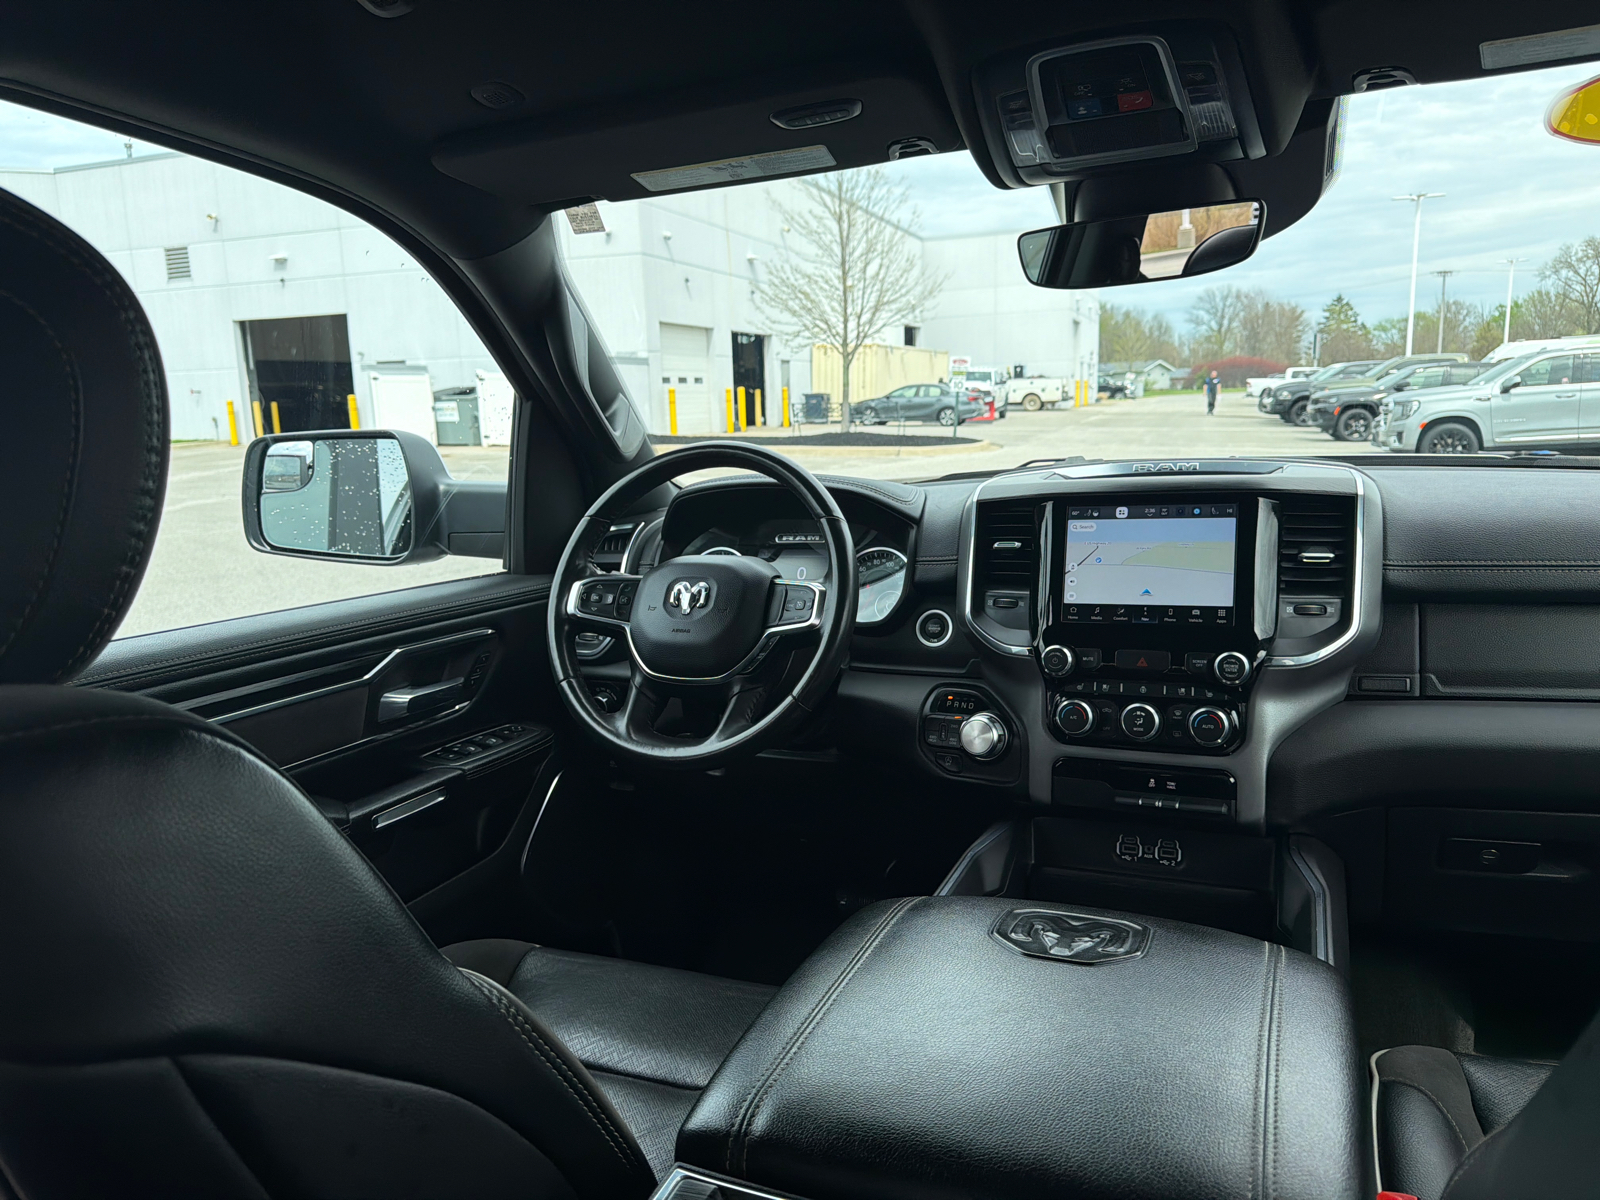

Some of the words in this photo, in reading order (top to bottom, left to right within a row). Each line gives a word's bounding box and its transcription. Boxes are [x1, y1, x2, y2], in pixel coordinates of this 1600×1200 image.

[953, 381, 964, 390] 10
[1132, 462, 1200, 472] RAM
[796, 566, 807, 580] 0
